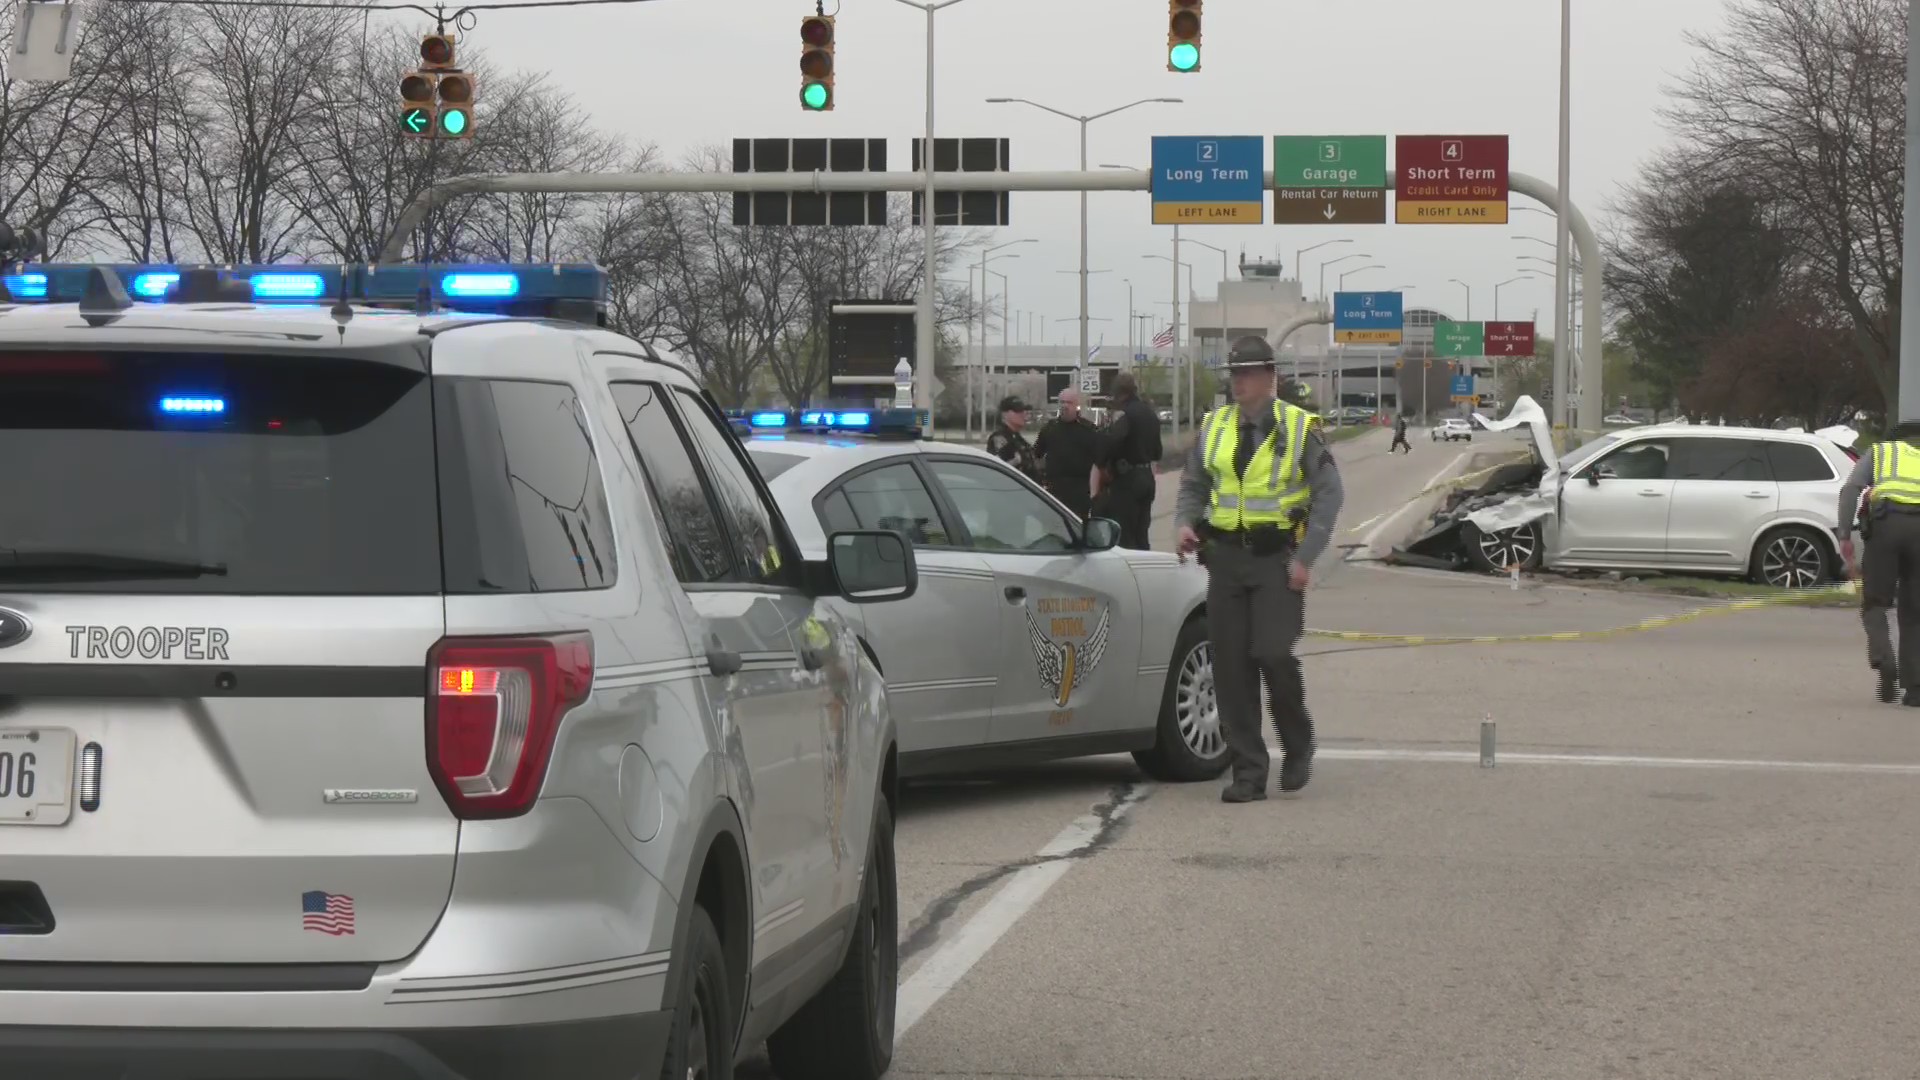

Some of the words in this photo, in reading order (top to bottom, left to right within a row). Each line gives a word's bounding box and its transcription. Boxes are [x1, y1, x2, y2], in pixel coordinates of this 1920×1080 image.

[1202, 145, 1213, 159] 2
[1325, 144, 1335, 159] 3
[1446, 143, 1458, 158] 4
[1166, 168, 1203, 183] Long
[1211, 168, 1249, 180] Term
[1302, 168, 1358, 182] Garage
[1408, 167, 1450, 179] Short
[1457, 167, 1496, 179] Term
[1281, 189, 1317, 199] Rental
[1320, 189, 1338, 199] Car
[1342, 189, 1379, 199] Return
[1407, 186, 1440, 195] Credit
[1444, 186, 1469, 195] Card
[1472, 186, 1498, 197] Only
[1178, 208, 1203, 217] LEFT
[1209, 208, 1238, 217] LANE
[1417, 207, 1452, 216] RIGHT
[1457, 207, 1487, 216] LANE
[1365, 297, 1372, 306] 2
[1343, 310, 1366, 319] Long
[1370, 310, 1393, 318] Term
[1082, 381, 1098, 391] 25
[65, 625, 230, 660] TROOPER
[344, 791, 412, 800] ECOBOOST
